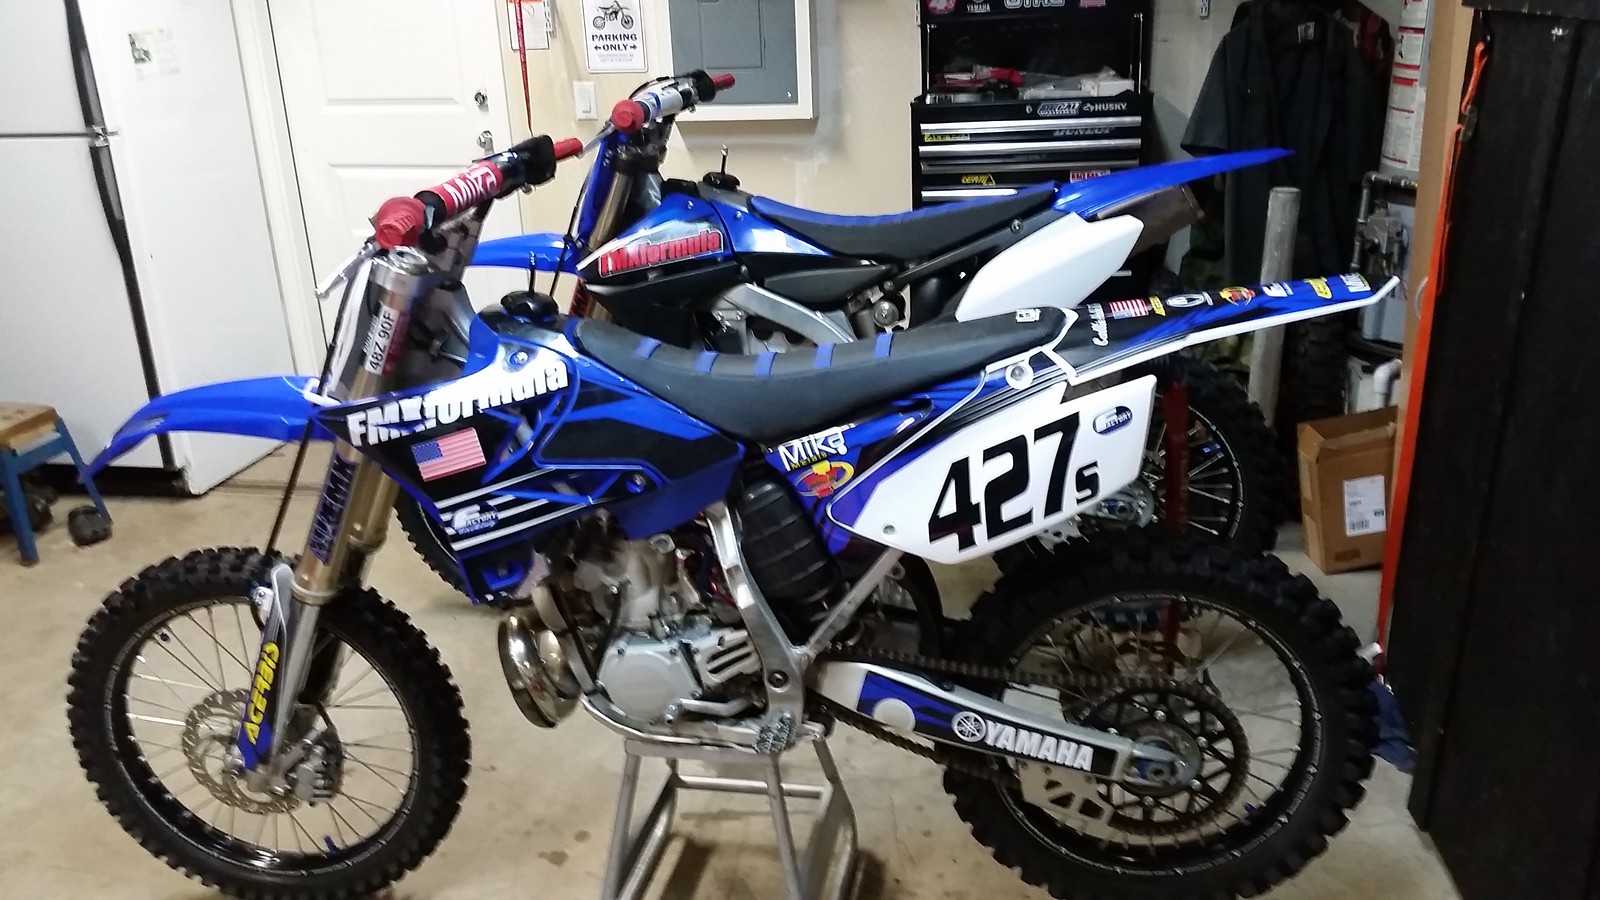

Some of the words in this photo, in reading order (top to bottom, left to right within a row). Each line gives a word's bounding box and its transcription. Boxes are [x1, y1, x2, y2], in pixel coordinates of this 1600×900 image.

[966, 4, 991, 12] YAMAHA
[591, 33, 638, 42] PARKING
[602, 43, 629, 52] ONLY
[1094, 102, 1128, 111] HUSKY
[369, 341, 387, 371] 48Z
[378, 310, 396, 341] 90F
[243, 642, 280, 746] ACERBIS
[984, 719, 1094, 772] YAMAHA
